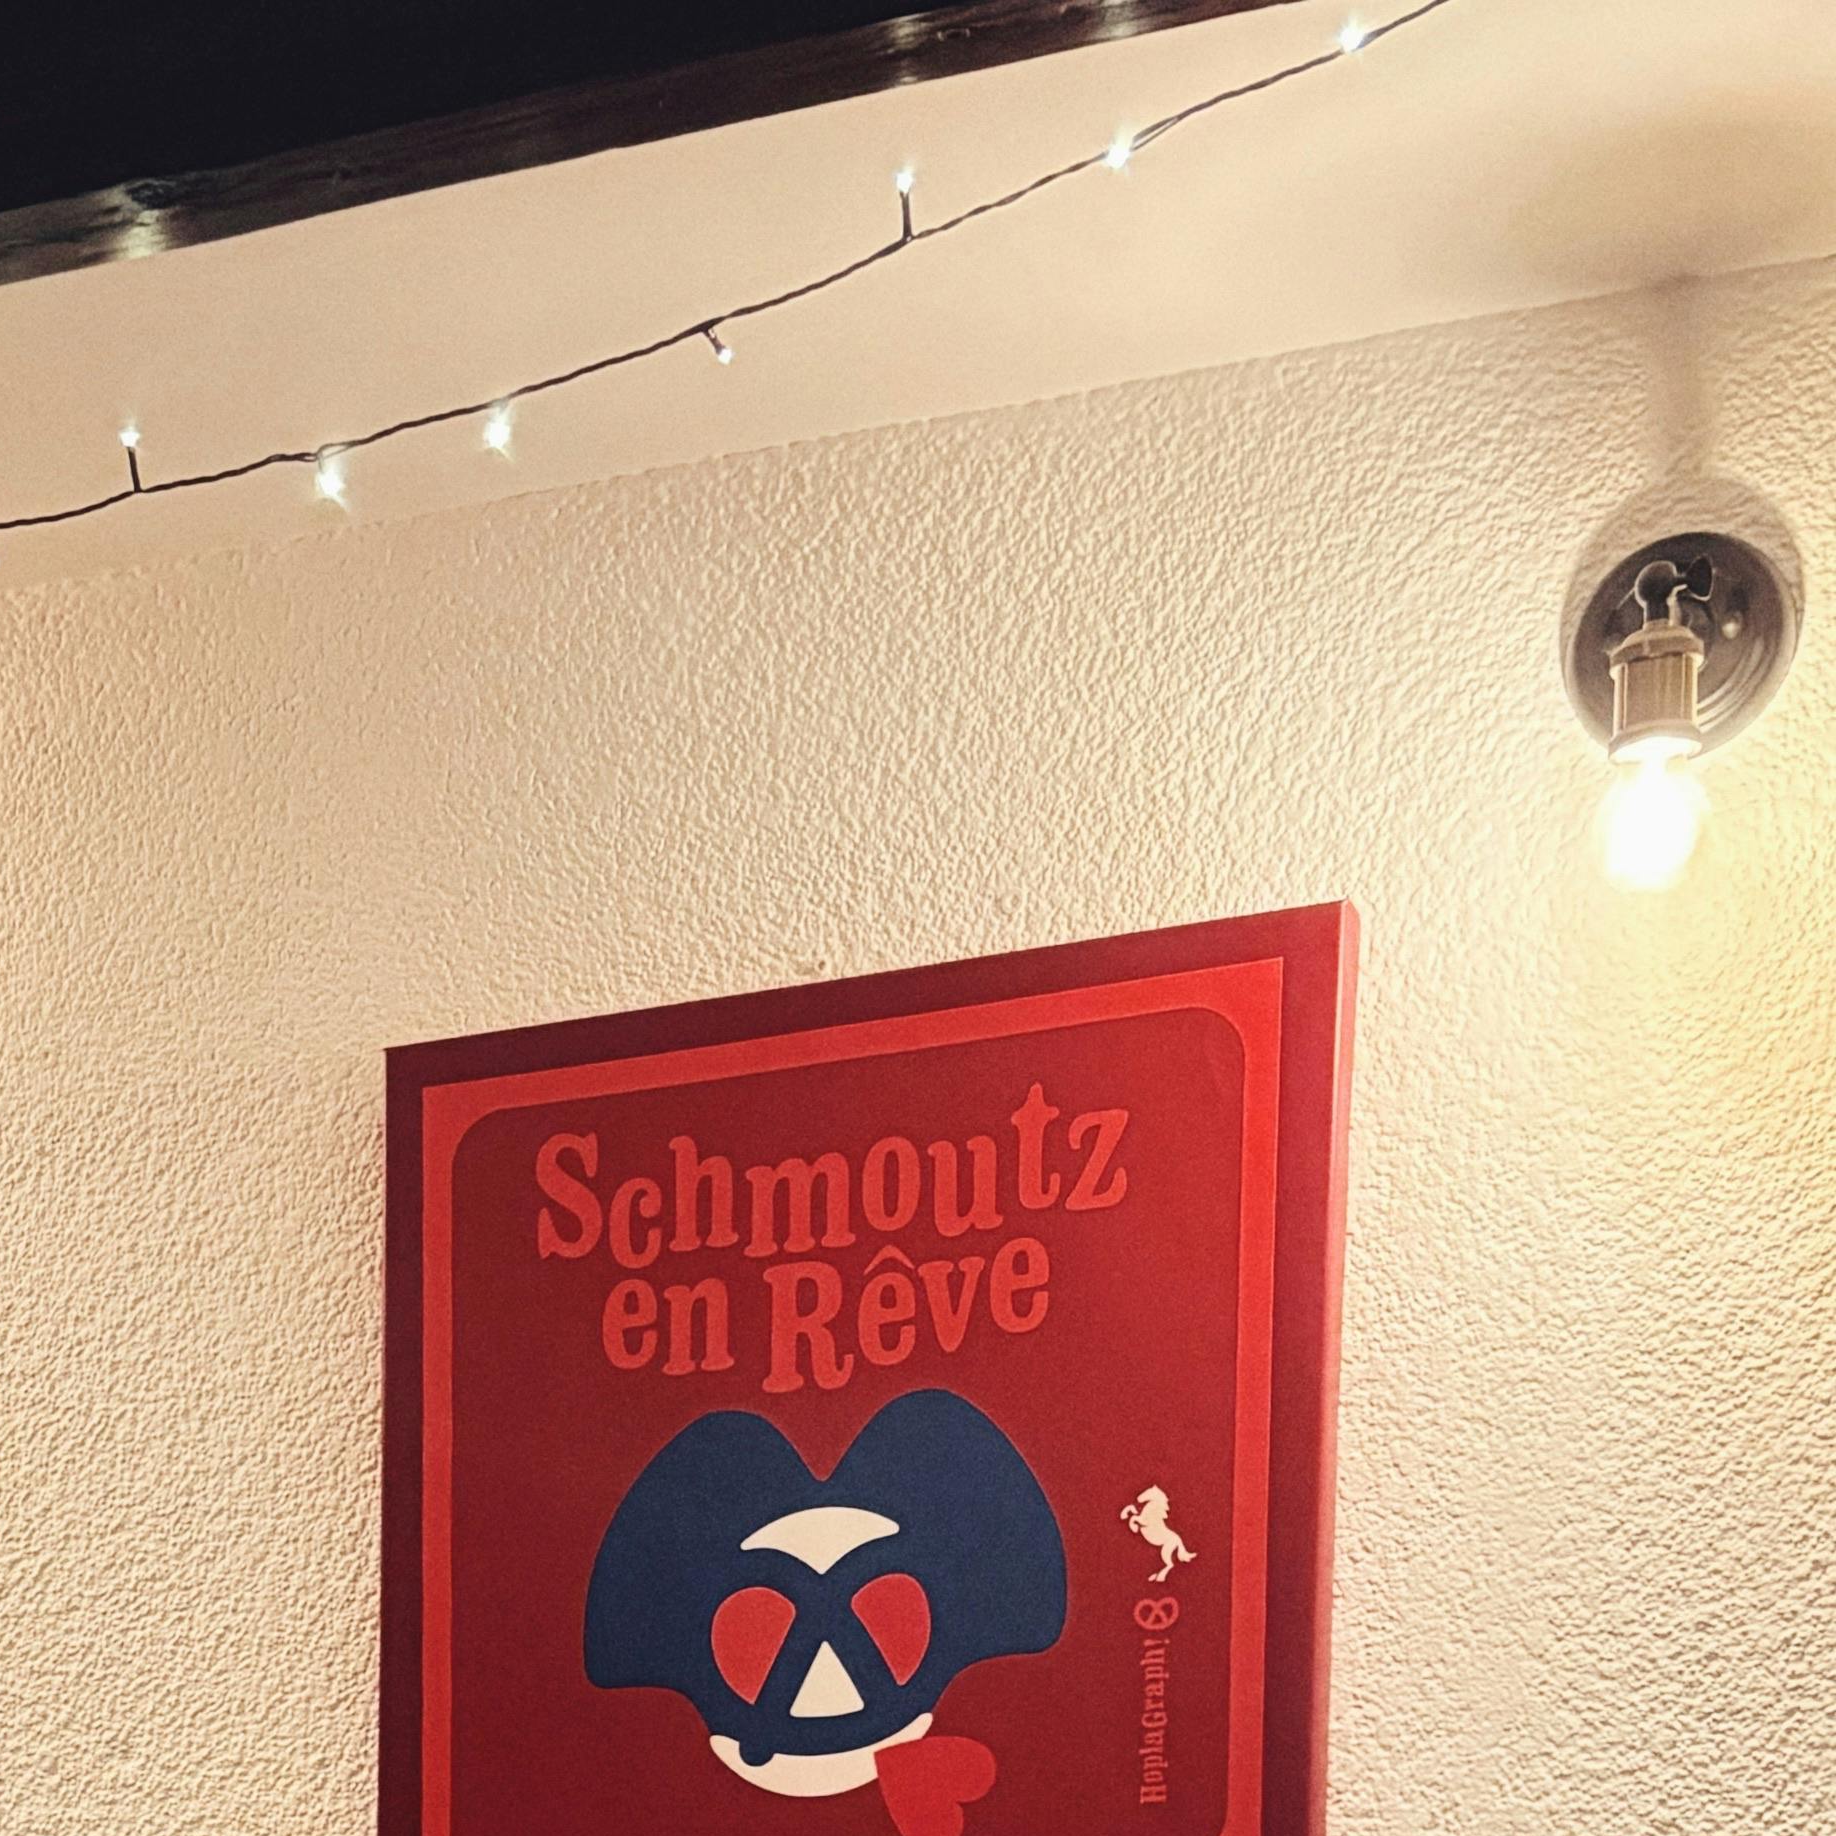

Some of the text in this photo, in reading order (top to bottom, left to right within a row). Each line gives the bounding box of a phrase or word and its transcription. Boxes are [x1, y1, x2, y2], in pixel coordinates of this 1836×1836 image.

[535, 1081, 1129, 1269] Schmoutz
[601, 1236, 1051, 1393] en Rêve
[1138, 1638, 1170, 1805] HoplaGraph!
